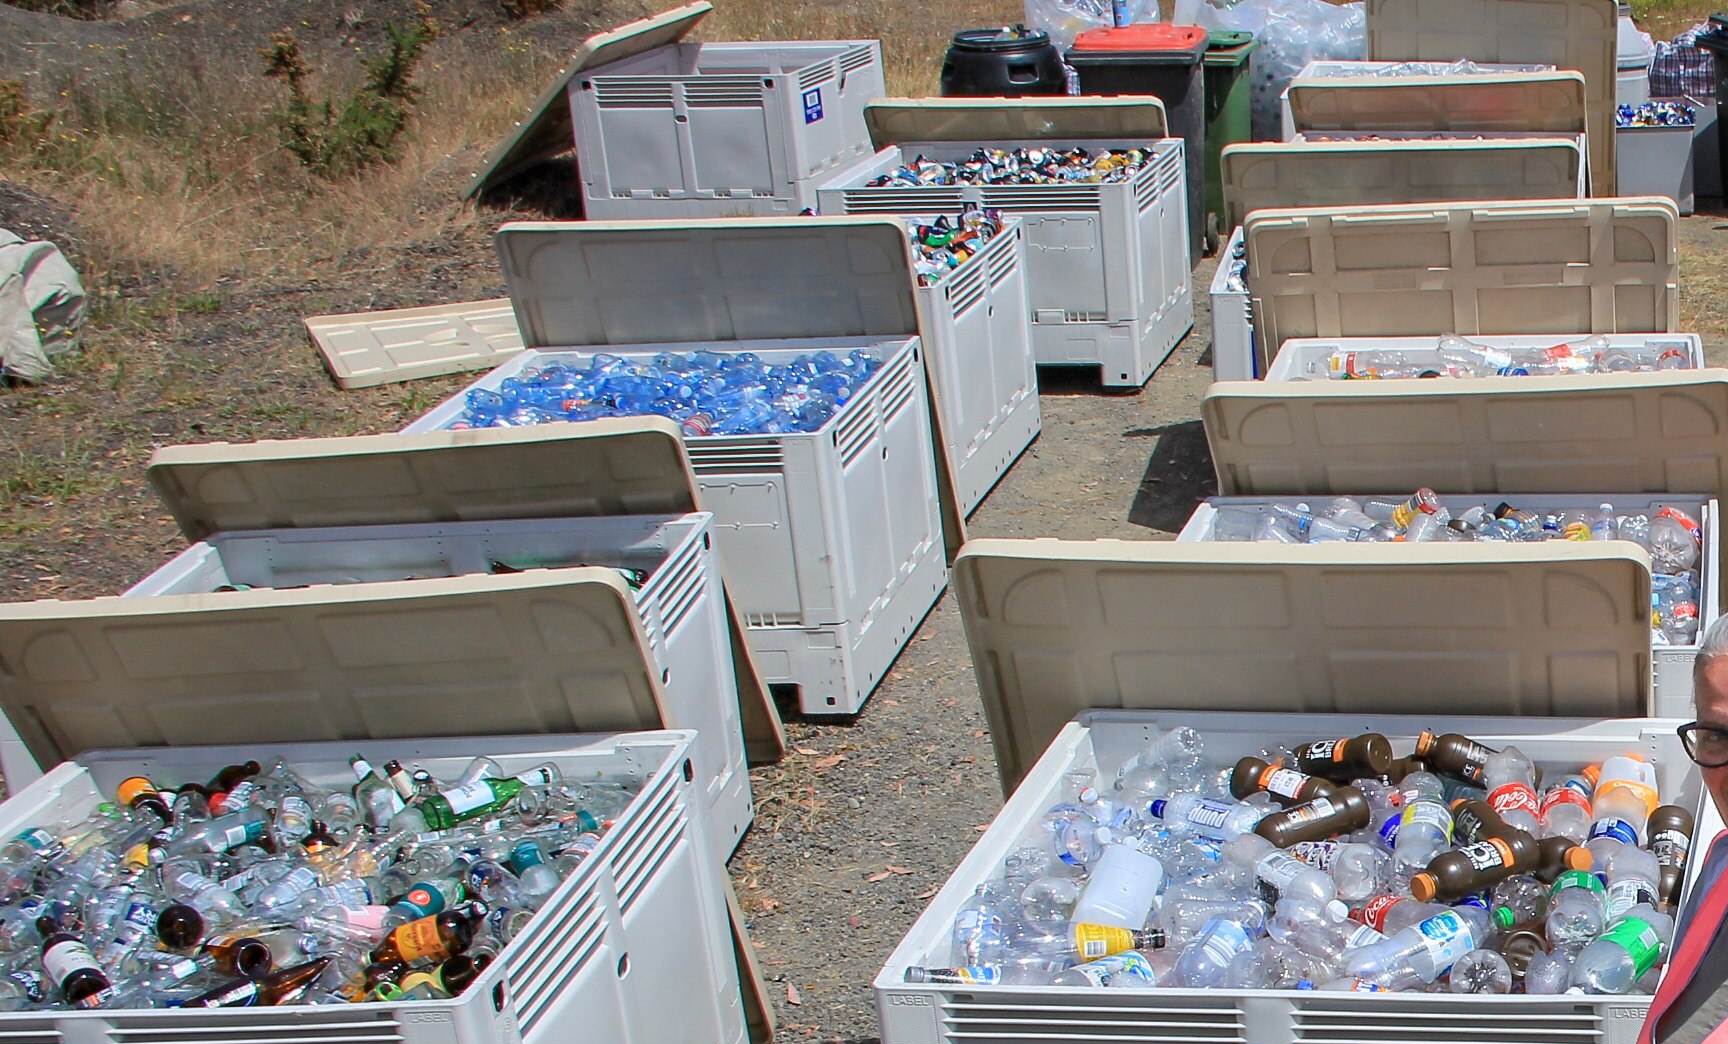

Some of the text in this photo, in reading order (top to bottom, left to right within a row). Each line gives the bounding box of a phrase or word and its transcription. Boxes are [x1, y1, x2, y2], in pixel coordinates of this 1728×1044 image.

[1187, 803, 1231, 829] pump
[892, 995, 930, 1006] LABEL
[1615, 1008, 1648, 1019] LABE
